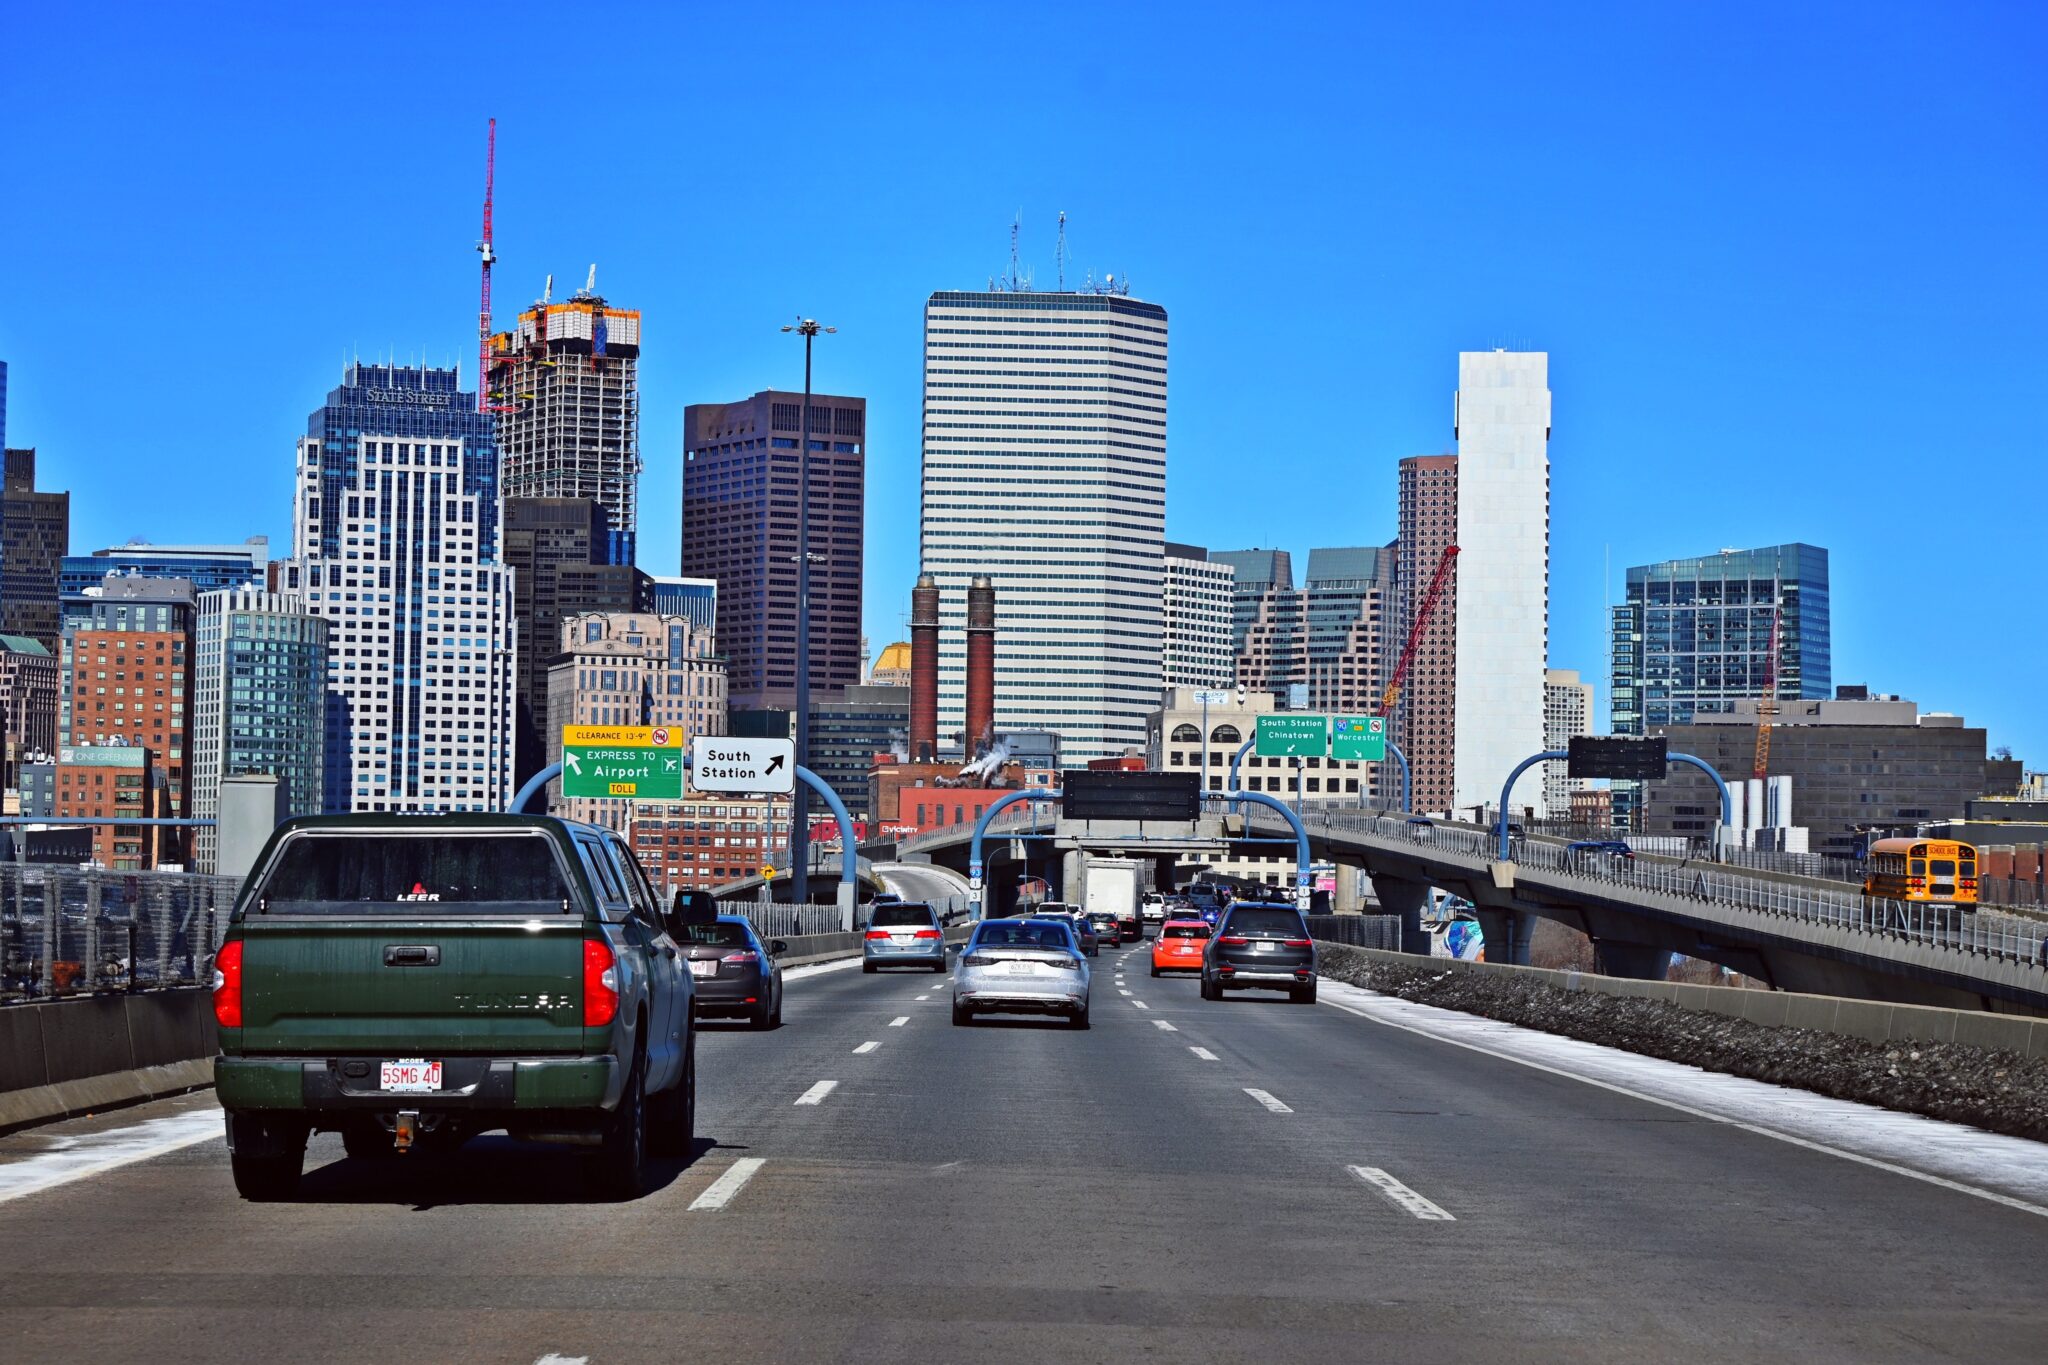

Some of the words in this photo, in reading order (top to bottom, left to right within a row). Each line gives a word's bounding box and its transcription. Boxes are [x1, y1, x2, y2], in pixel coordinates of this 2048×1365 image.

[366, 389, 404, 403] STATE
[406, 391, 451, 405] STREET
[1261, 719, 1286, 727] South
[1290, 719, 1323, 728] Station
[1336, 721, 1347, 730] 90
[576, 731, 621, 740] CLEARANCE
[1268, 731, 1314, 739] Chinatown
[1337, 734, 1380, 742] Worcester
[76, 752, 96, 761] ONE
[97, 753, 143, 762] GREENWAY
[587, 751, 636, 761] EXPRESS
[642, 752, 656, 761] TO
[708, 749, 751, 762] South
[594, 766, 649, 780] Airport
[702, 767, 756, 779] Station
[611, 784, 635, 794] TOLL
[1929, 846, 1946, 855] SCHOOL
[1947, 847, 1956, 855] BUS
[397, 893, 440, 902] LEER
[383, 1067, 418, 1084] 5SMG
